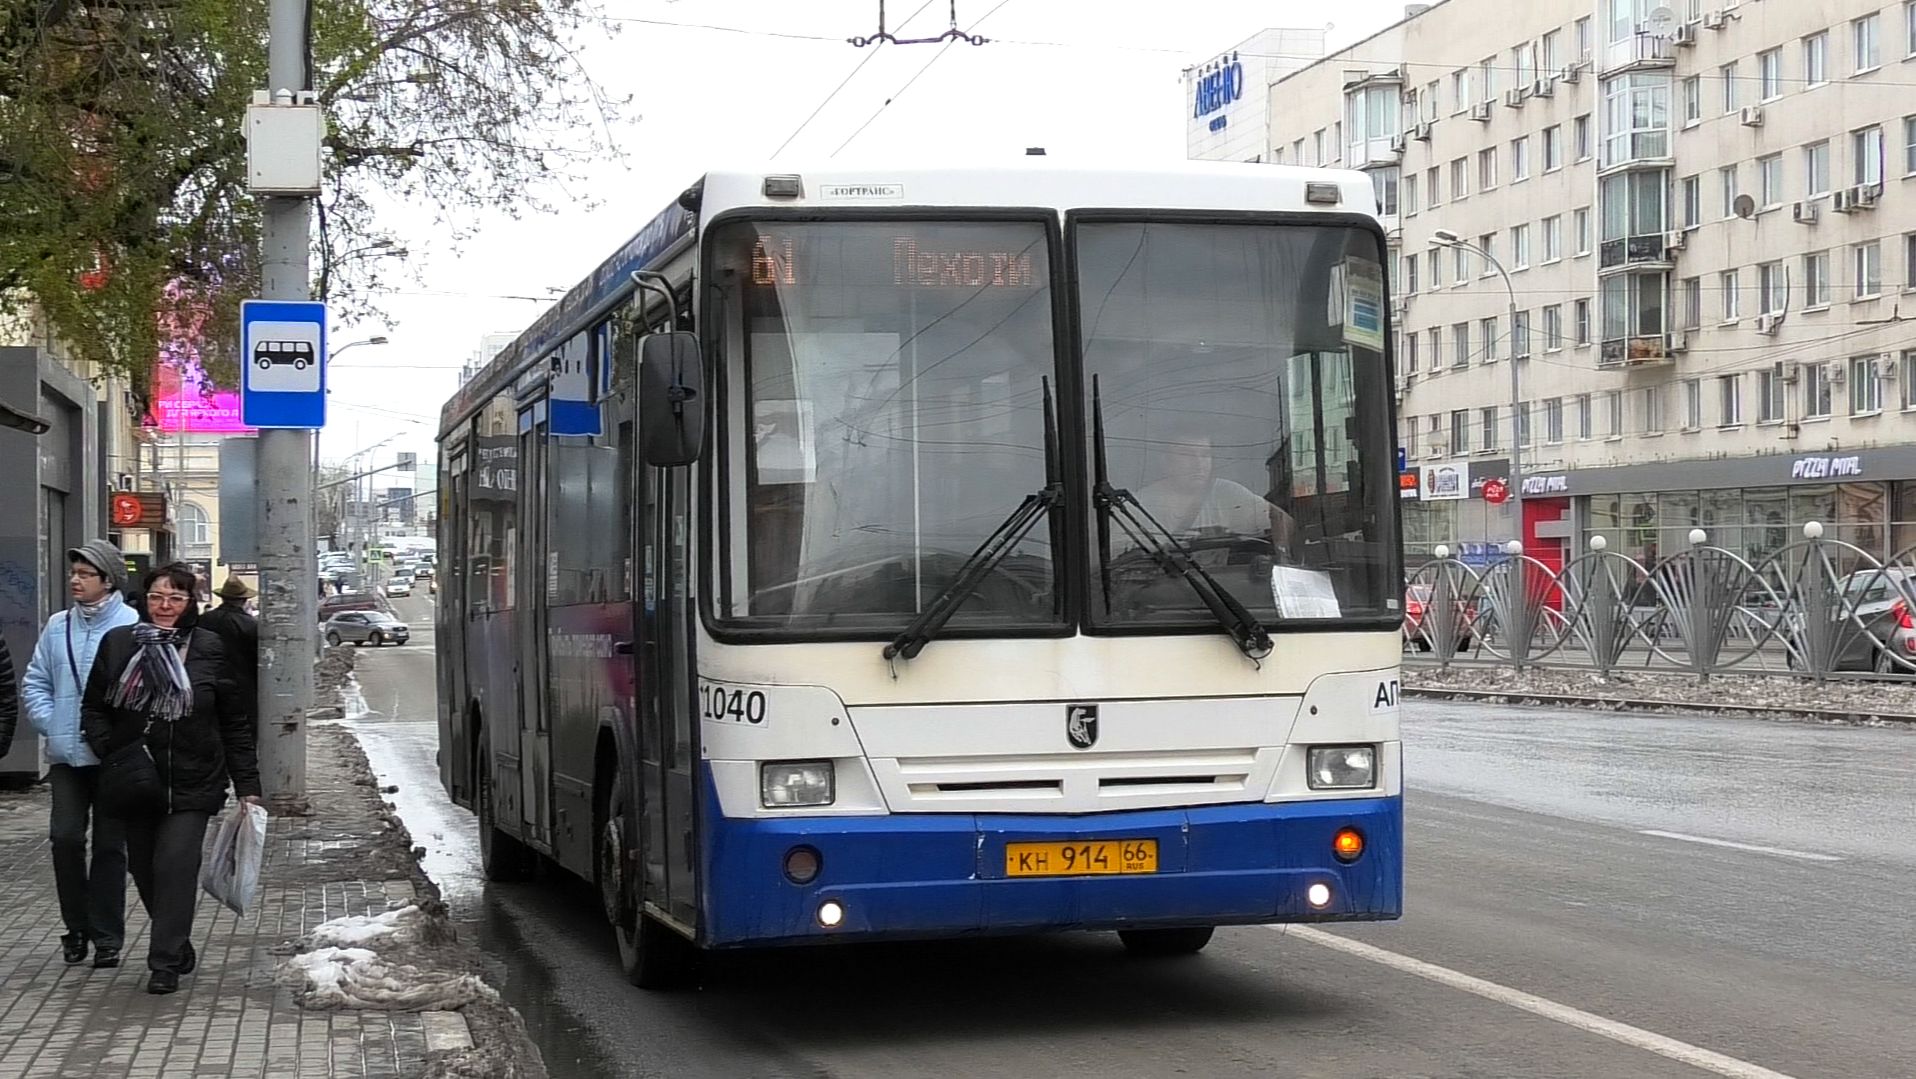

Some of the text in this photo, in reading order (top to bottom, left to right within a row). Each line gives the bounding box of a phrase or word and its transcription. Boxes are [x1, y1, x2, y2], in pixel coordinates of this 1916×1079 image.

[1019, 842, 1147, 872] КН 914 66
[1126, 862, 1144, 871] RUS
